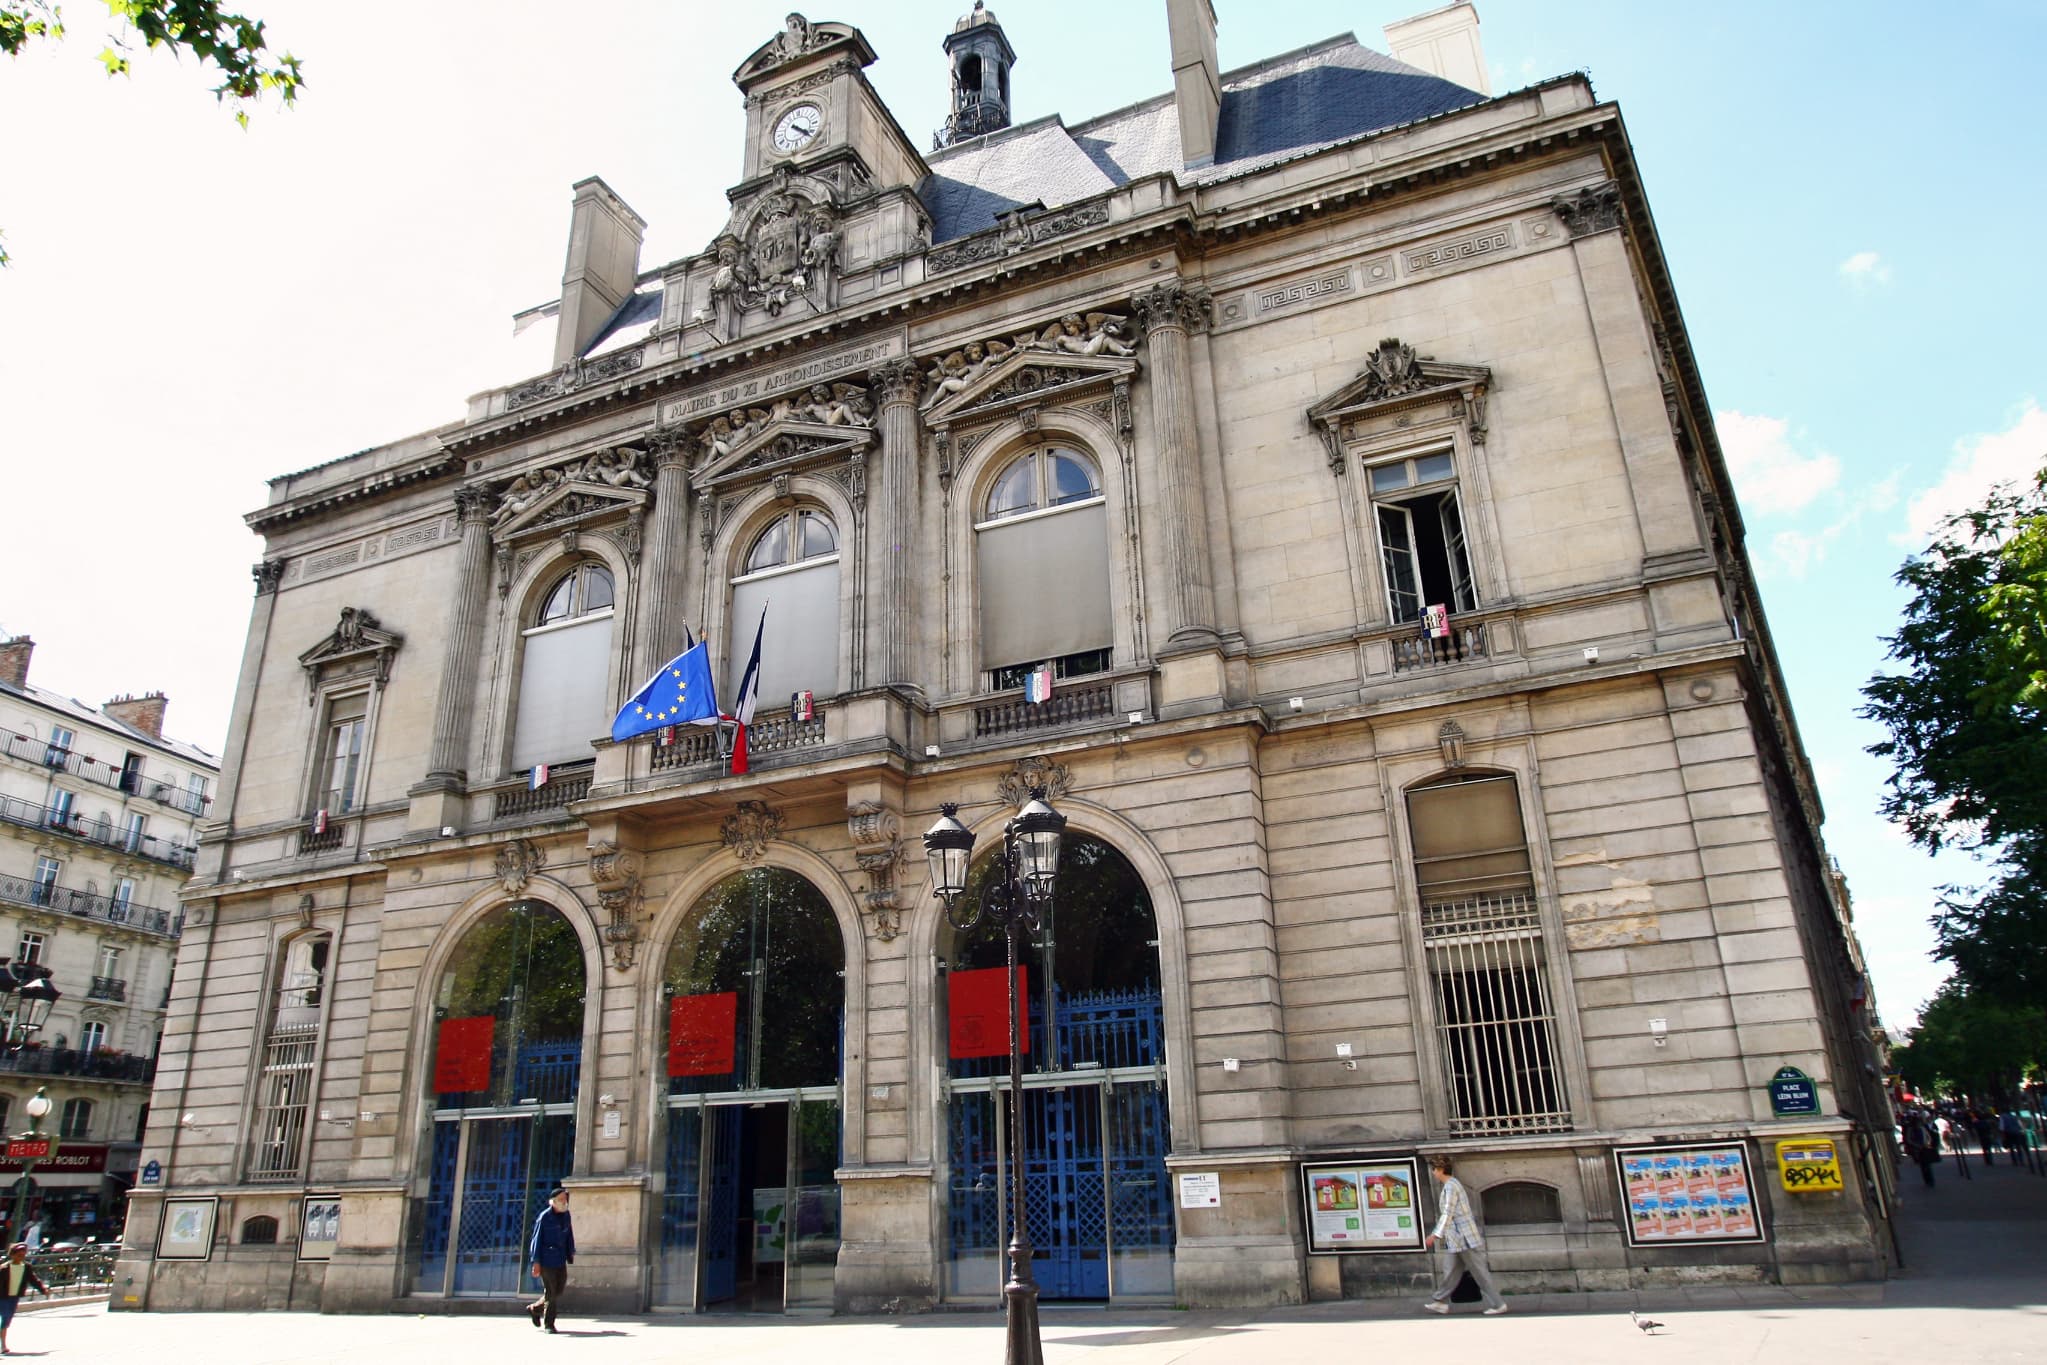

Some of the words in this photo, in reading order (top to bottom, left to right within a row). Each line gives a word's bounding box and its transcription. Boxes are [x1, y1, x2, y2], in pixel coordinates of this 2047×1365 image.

[670, 394, 717, 418] MAIRIE
[720, 387, 738, 404] DU
[743, 382, 758, 397] XI
[763, 342, 890, 391] ARRONDISSEMENT
[1782, 1084, 1800, 1092] PLACE
[55, 1155, 91, 1166] ROBLOT
